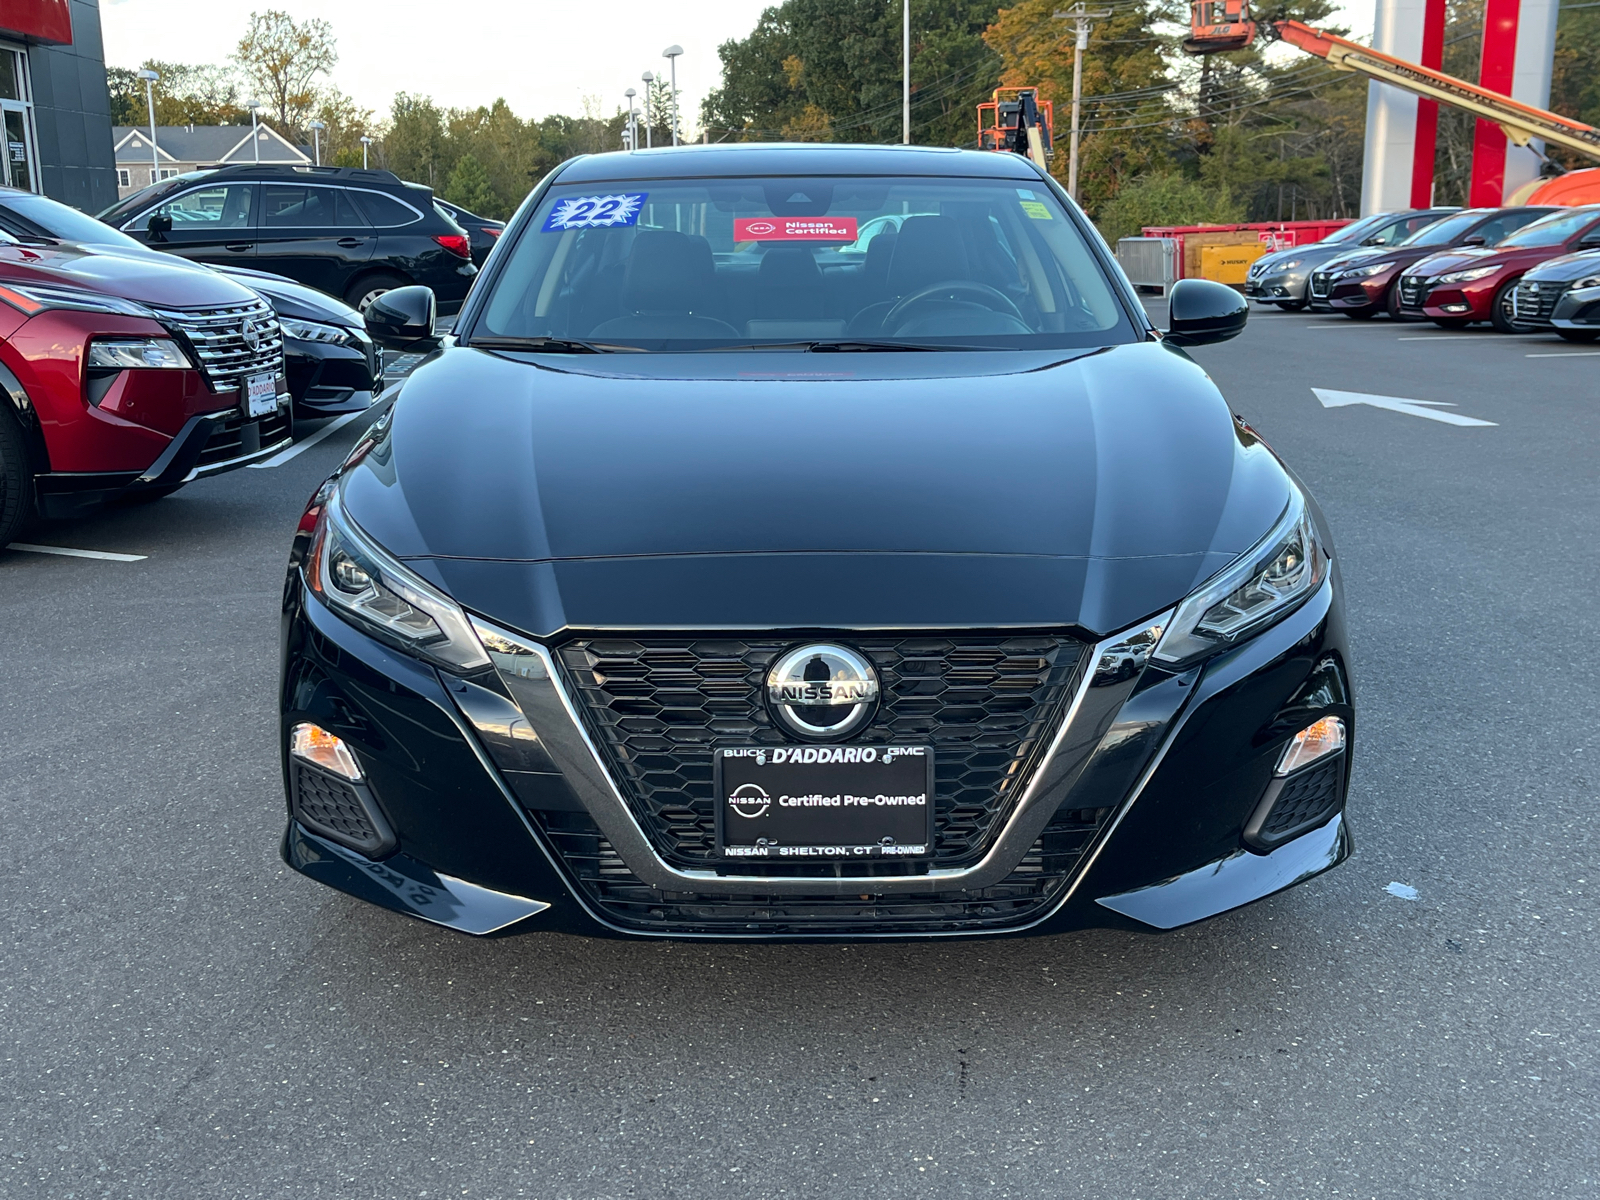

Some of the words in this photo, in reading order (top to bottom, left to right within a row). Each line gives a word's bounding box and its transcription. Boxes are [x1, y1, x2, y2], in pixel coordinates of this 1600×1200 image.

[1211, 26, 1230, 34] JLG
[567, 200, 621, 222] 22
[781, 686, 864, 700] NISSAN
[723, 749, 766, 757] BUICK
[772, 747, 877, 764] D'ADDARIO
[887, 747, 925, 756] GMC
[728, 797, 771, 805] NISSAN
[778, 794, 841, 807] Certified
[843, 793, 926, 807] Pre-Owned
[725, 848, 768, 856] NISSAN
[779, 846, 850, 856] SHELTON,
[853, 846, 873, 855] CT
[881, 847, 925, 855] PRE-OWNED
